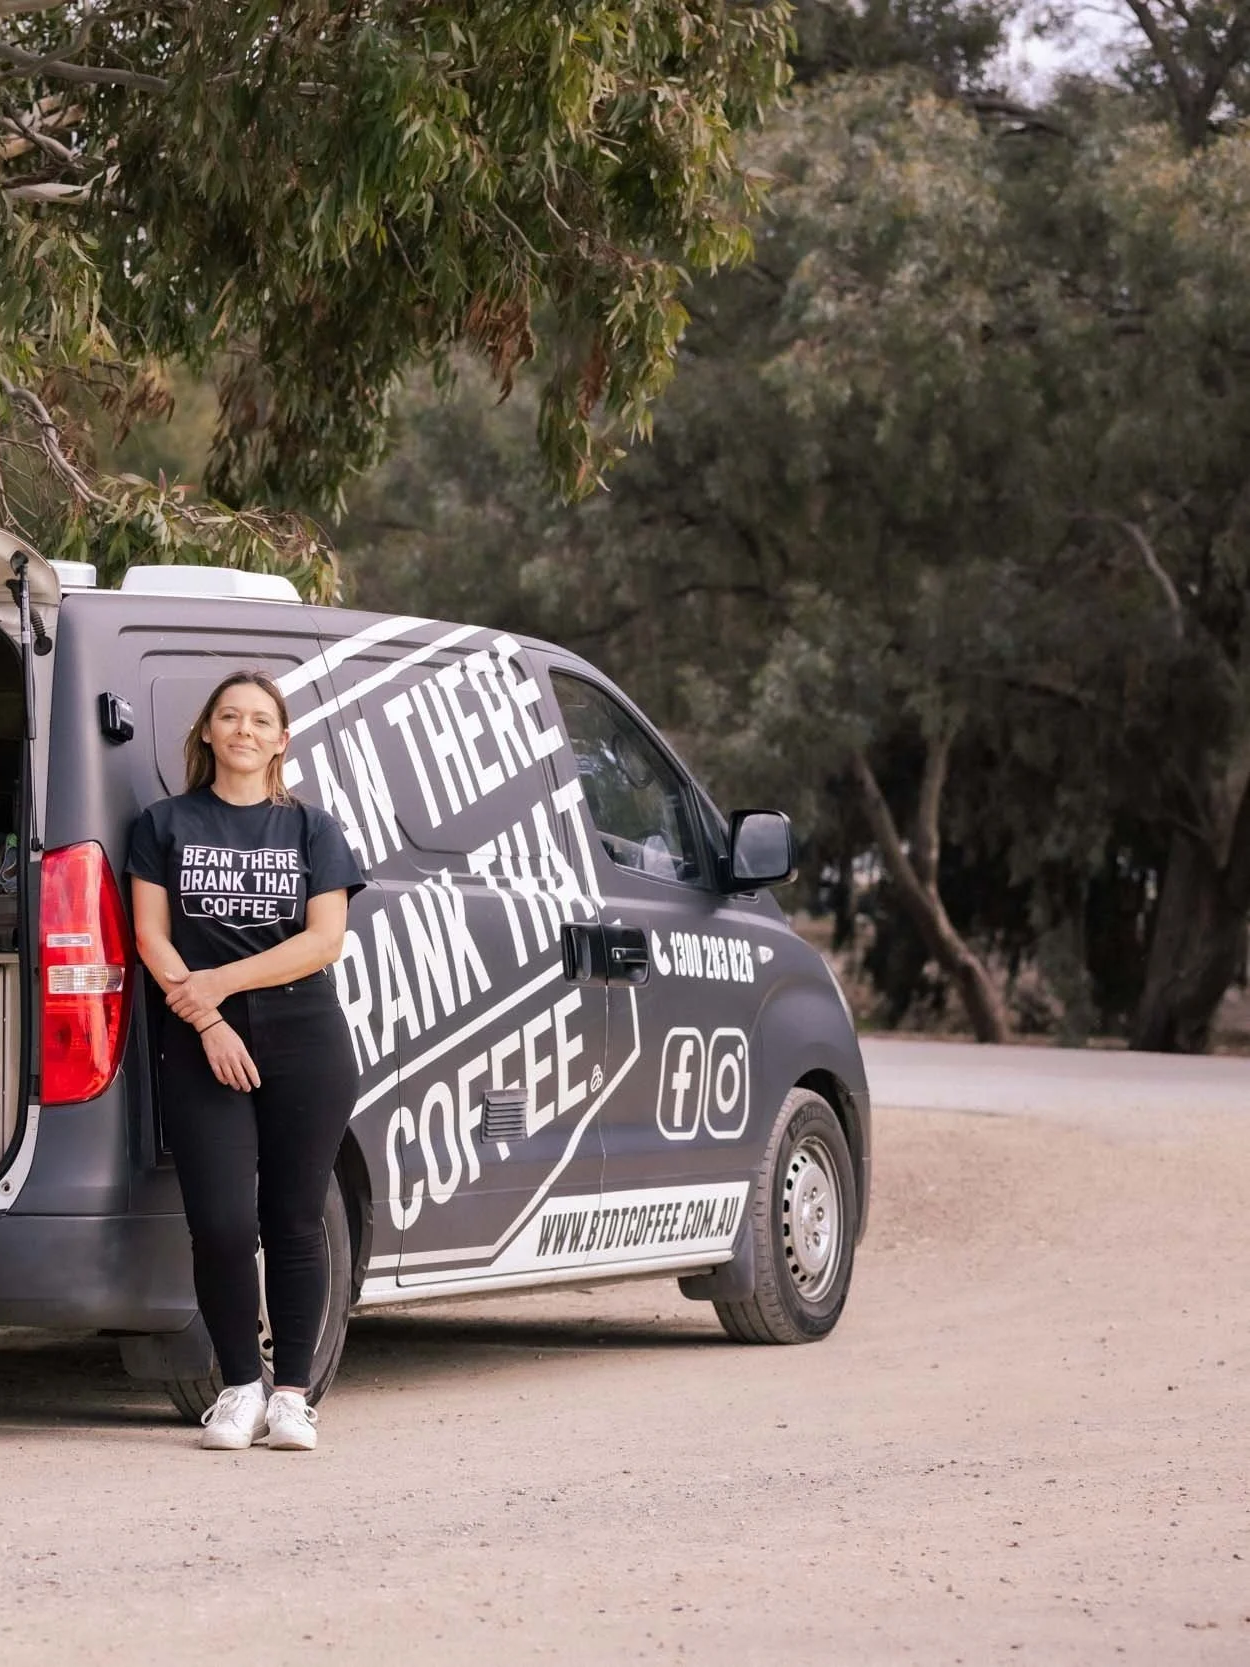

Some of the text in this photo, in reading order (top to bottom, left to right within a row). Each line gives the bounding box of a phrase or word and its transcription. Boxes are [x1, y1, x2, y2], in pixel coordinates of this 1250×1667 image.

[383, 634, 564, 829] THERE
[180, 869, 300, 895] DRANK THAT
[182, 847, 299, 870] BEAN THERE
[201, 897, 278, 919] COFFEE
[333, 777, 607, 1076] RANK THAT
[670, 931, 755, 984] 1300 283 826
[386, 987, 588, 1231] COFFEE
[536, 1197, 740, 1256] WWW.BTDTCOFFEE.COM.AU
